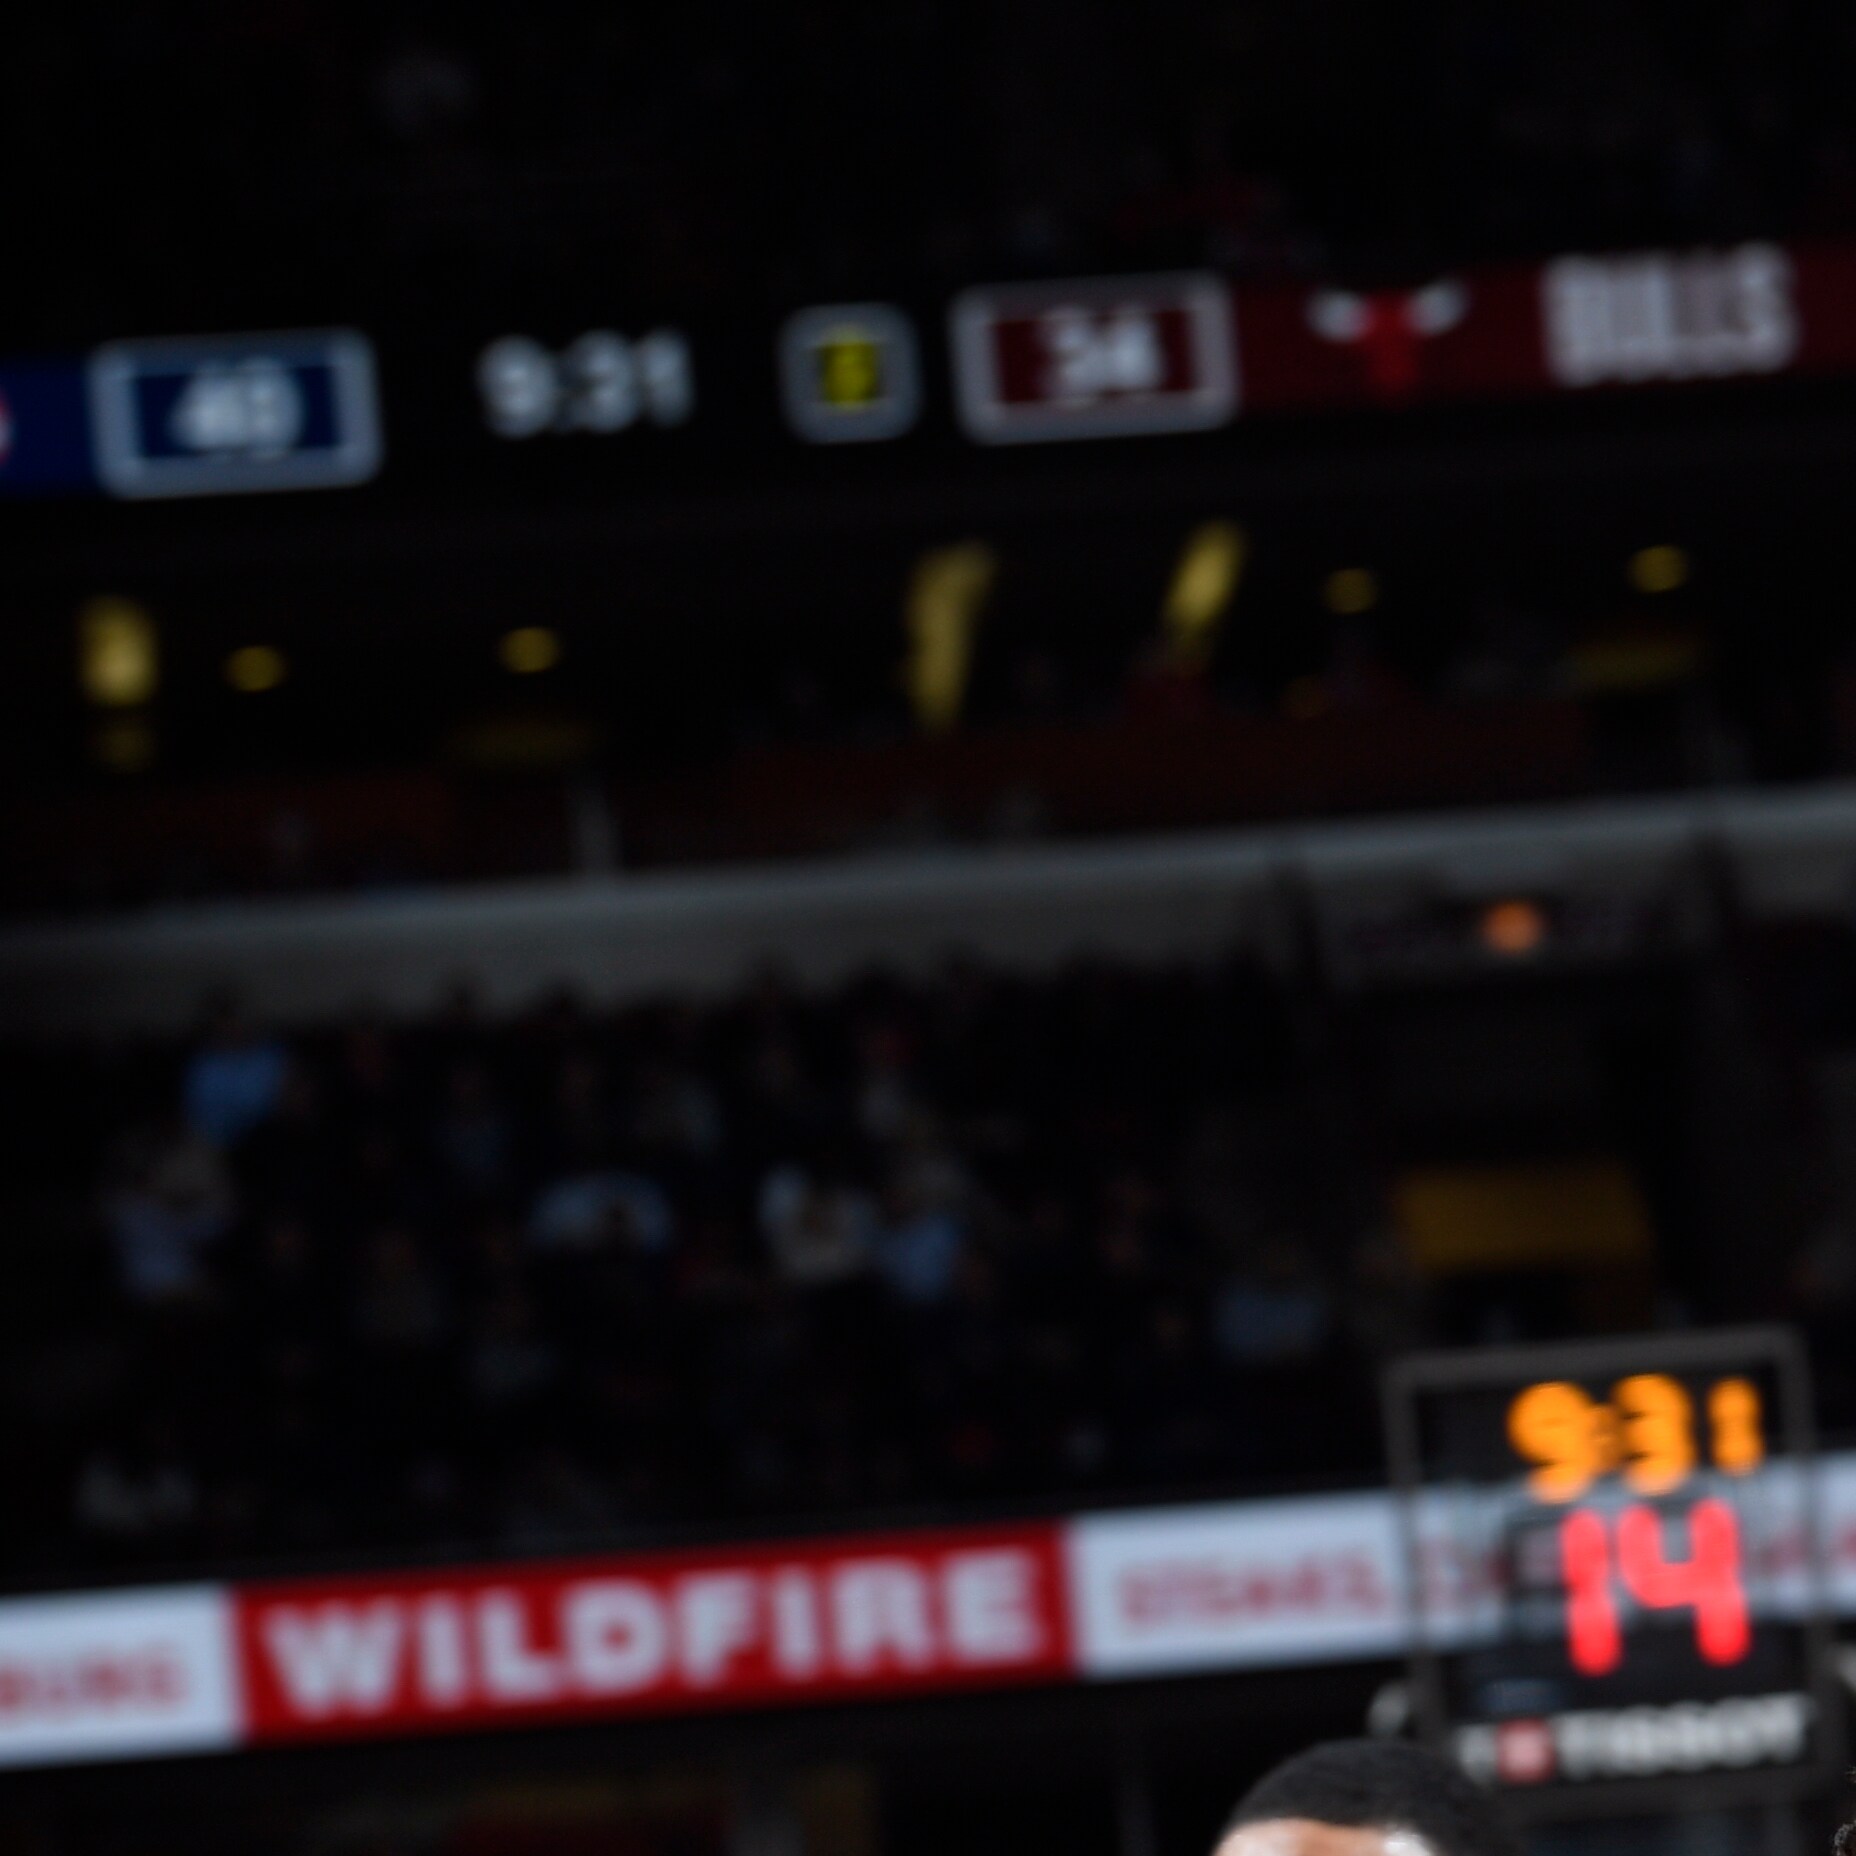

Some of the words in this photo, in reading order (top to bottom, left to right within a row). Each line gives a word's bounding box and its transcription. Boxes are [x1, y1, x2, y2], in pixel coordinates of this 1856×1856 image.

[1508, 1375, 1762, 1502] 9:31
[262, 1546, 1044, 1717] WILDFIRE
[1560, 1499, 1752, 1676] 14
